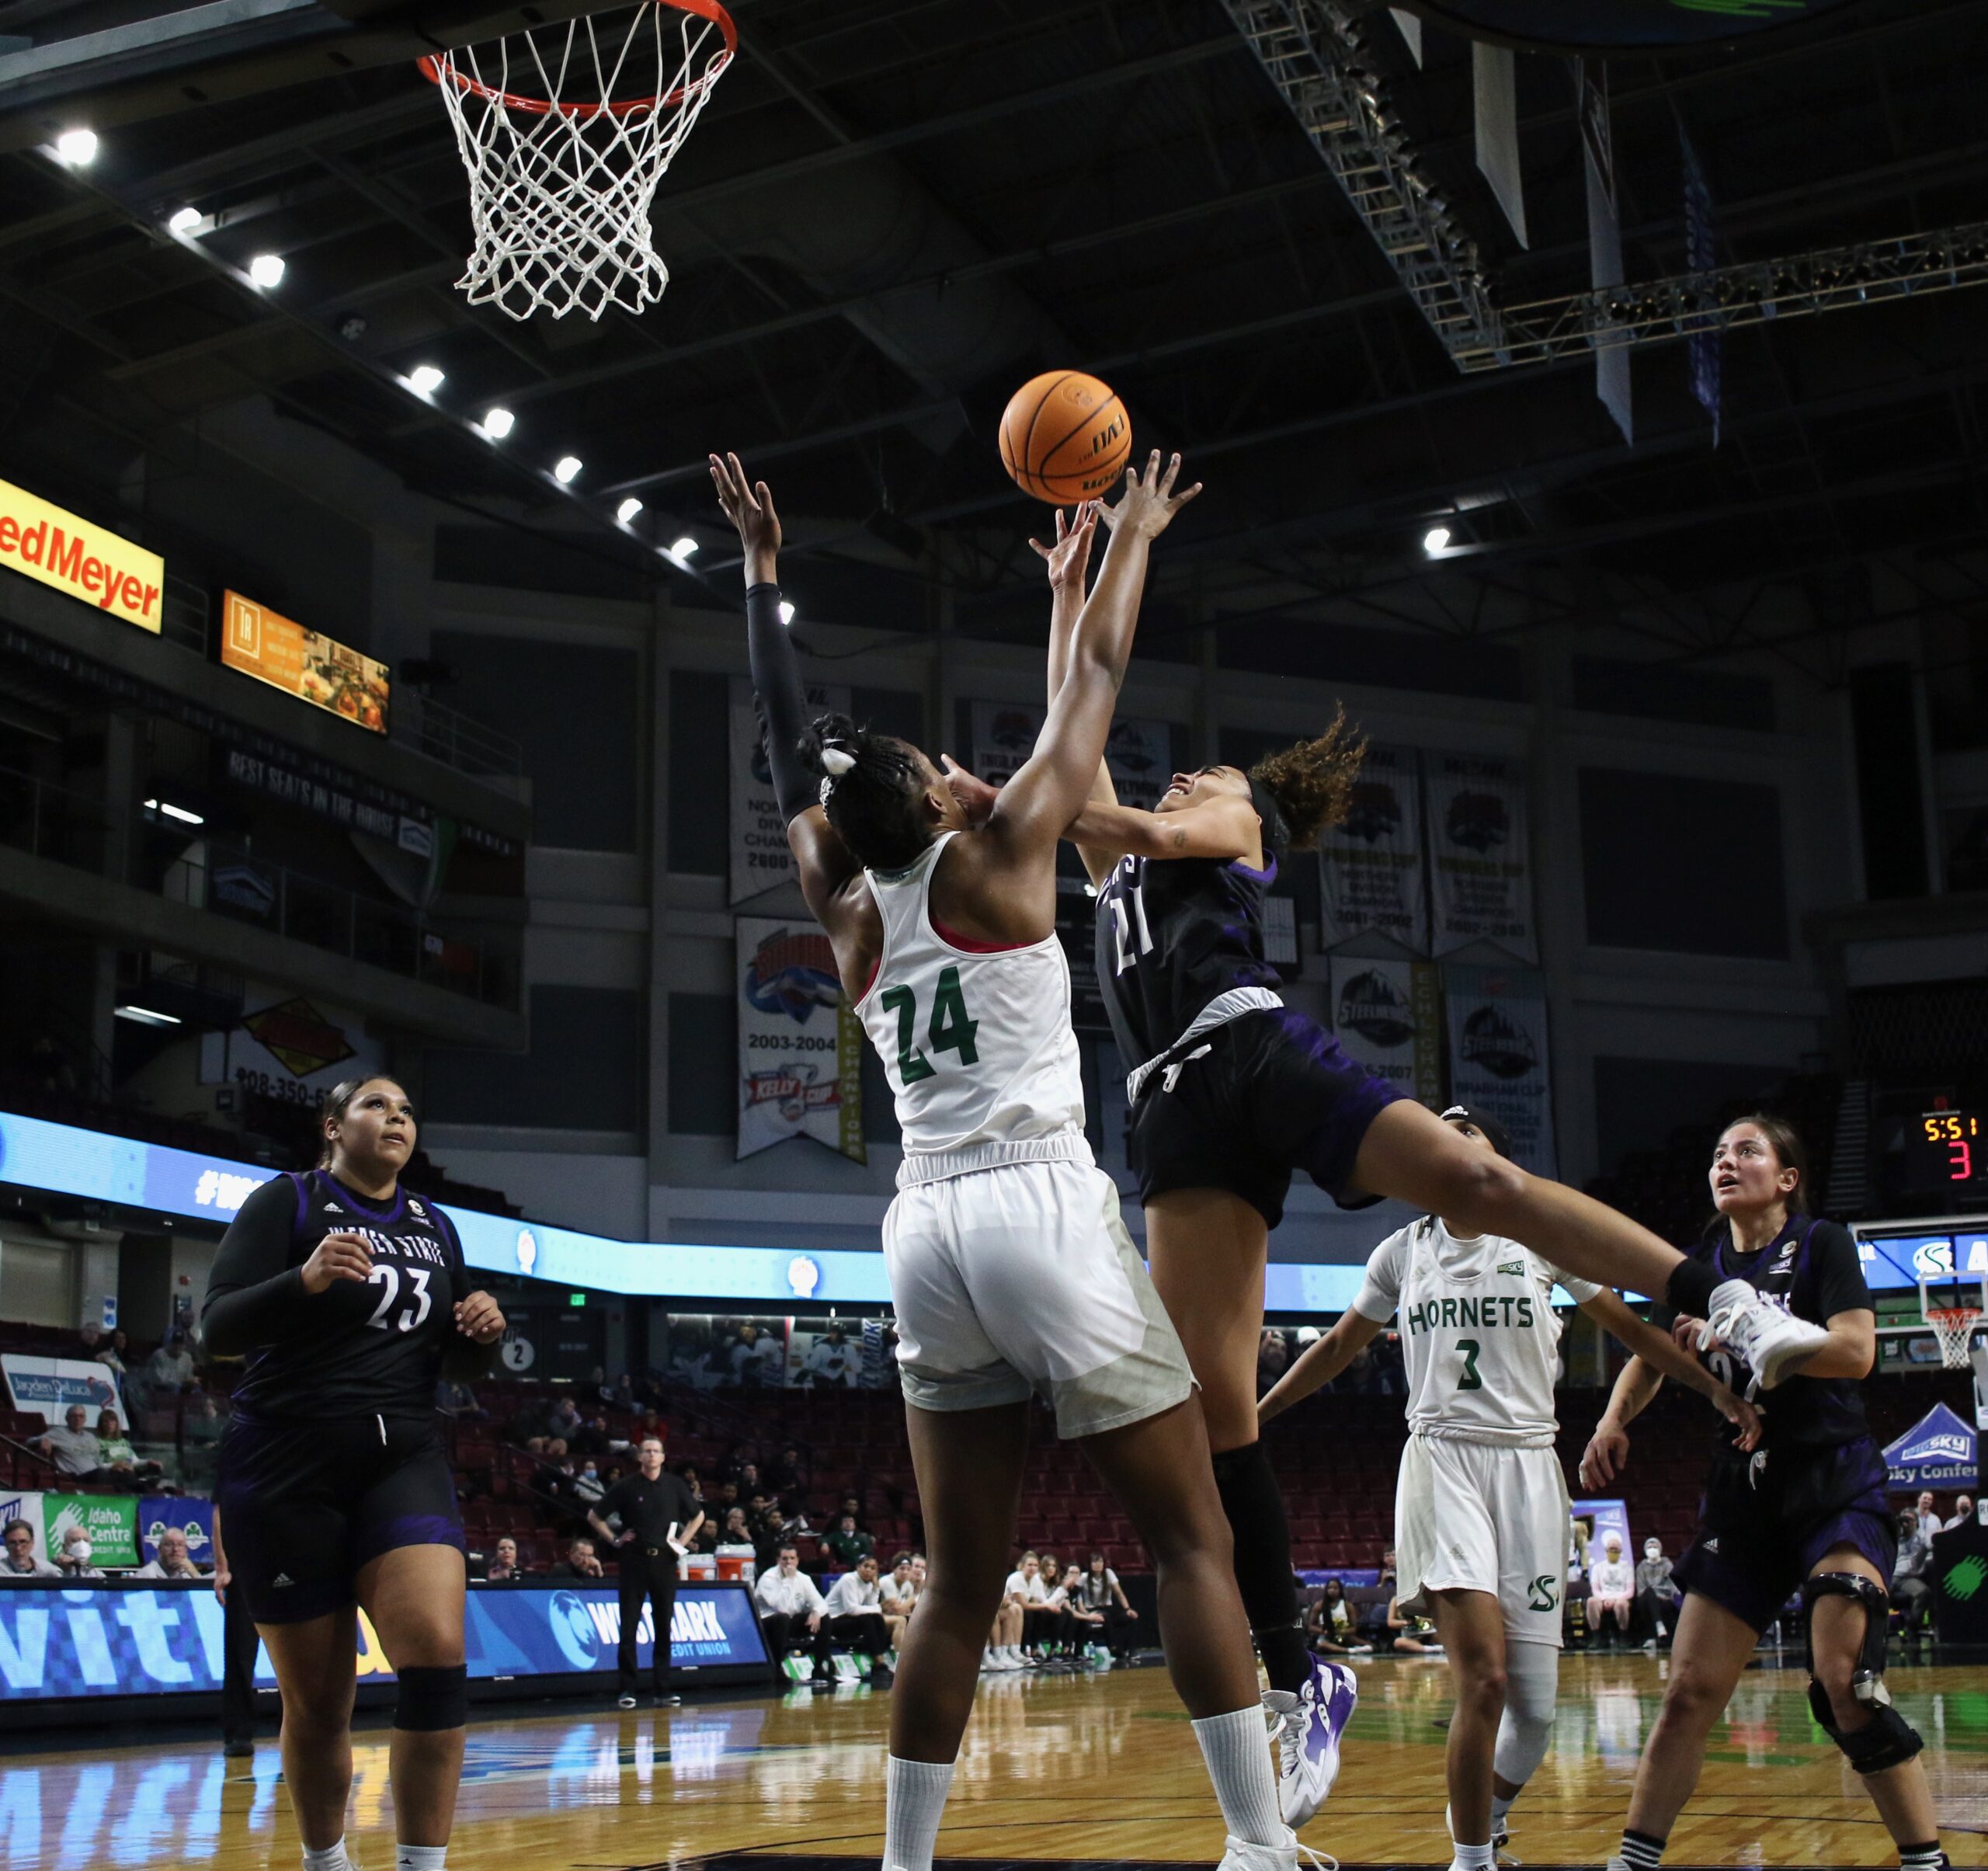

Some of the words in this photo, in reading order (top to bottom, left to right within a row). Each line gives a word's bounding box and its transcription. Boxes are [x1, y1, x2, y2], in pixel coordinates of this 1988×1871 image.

[47, 526, 159, 617] Meyer
[229, 749, 265, 788] BEST
[748, 1032, 836, 1052] 2003-2004
[880, 966, 980, 1087] 24
[756, 1080, 797, 1101] KELLY
[1924, 1116, 1979, 1142] 5:51
[1947, 1140, 1972, 1181] 3
[393, 1235, 446, 1268] STATE
[364, 1263, 433, 1333] 23
[1408, 1296, 1534, 1336] HORNETS
[514, 1344, 523, 1364] 2
[1455, 1339, 1482, 1391] 3
[88, 1507, 121, 1525] Idaho
[89, 1525, 131, 1542] Centra
[696, 1642, 732, 1657] UNION
